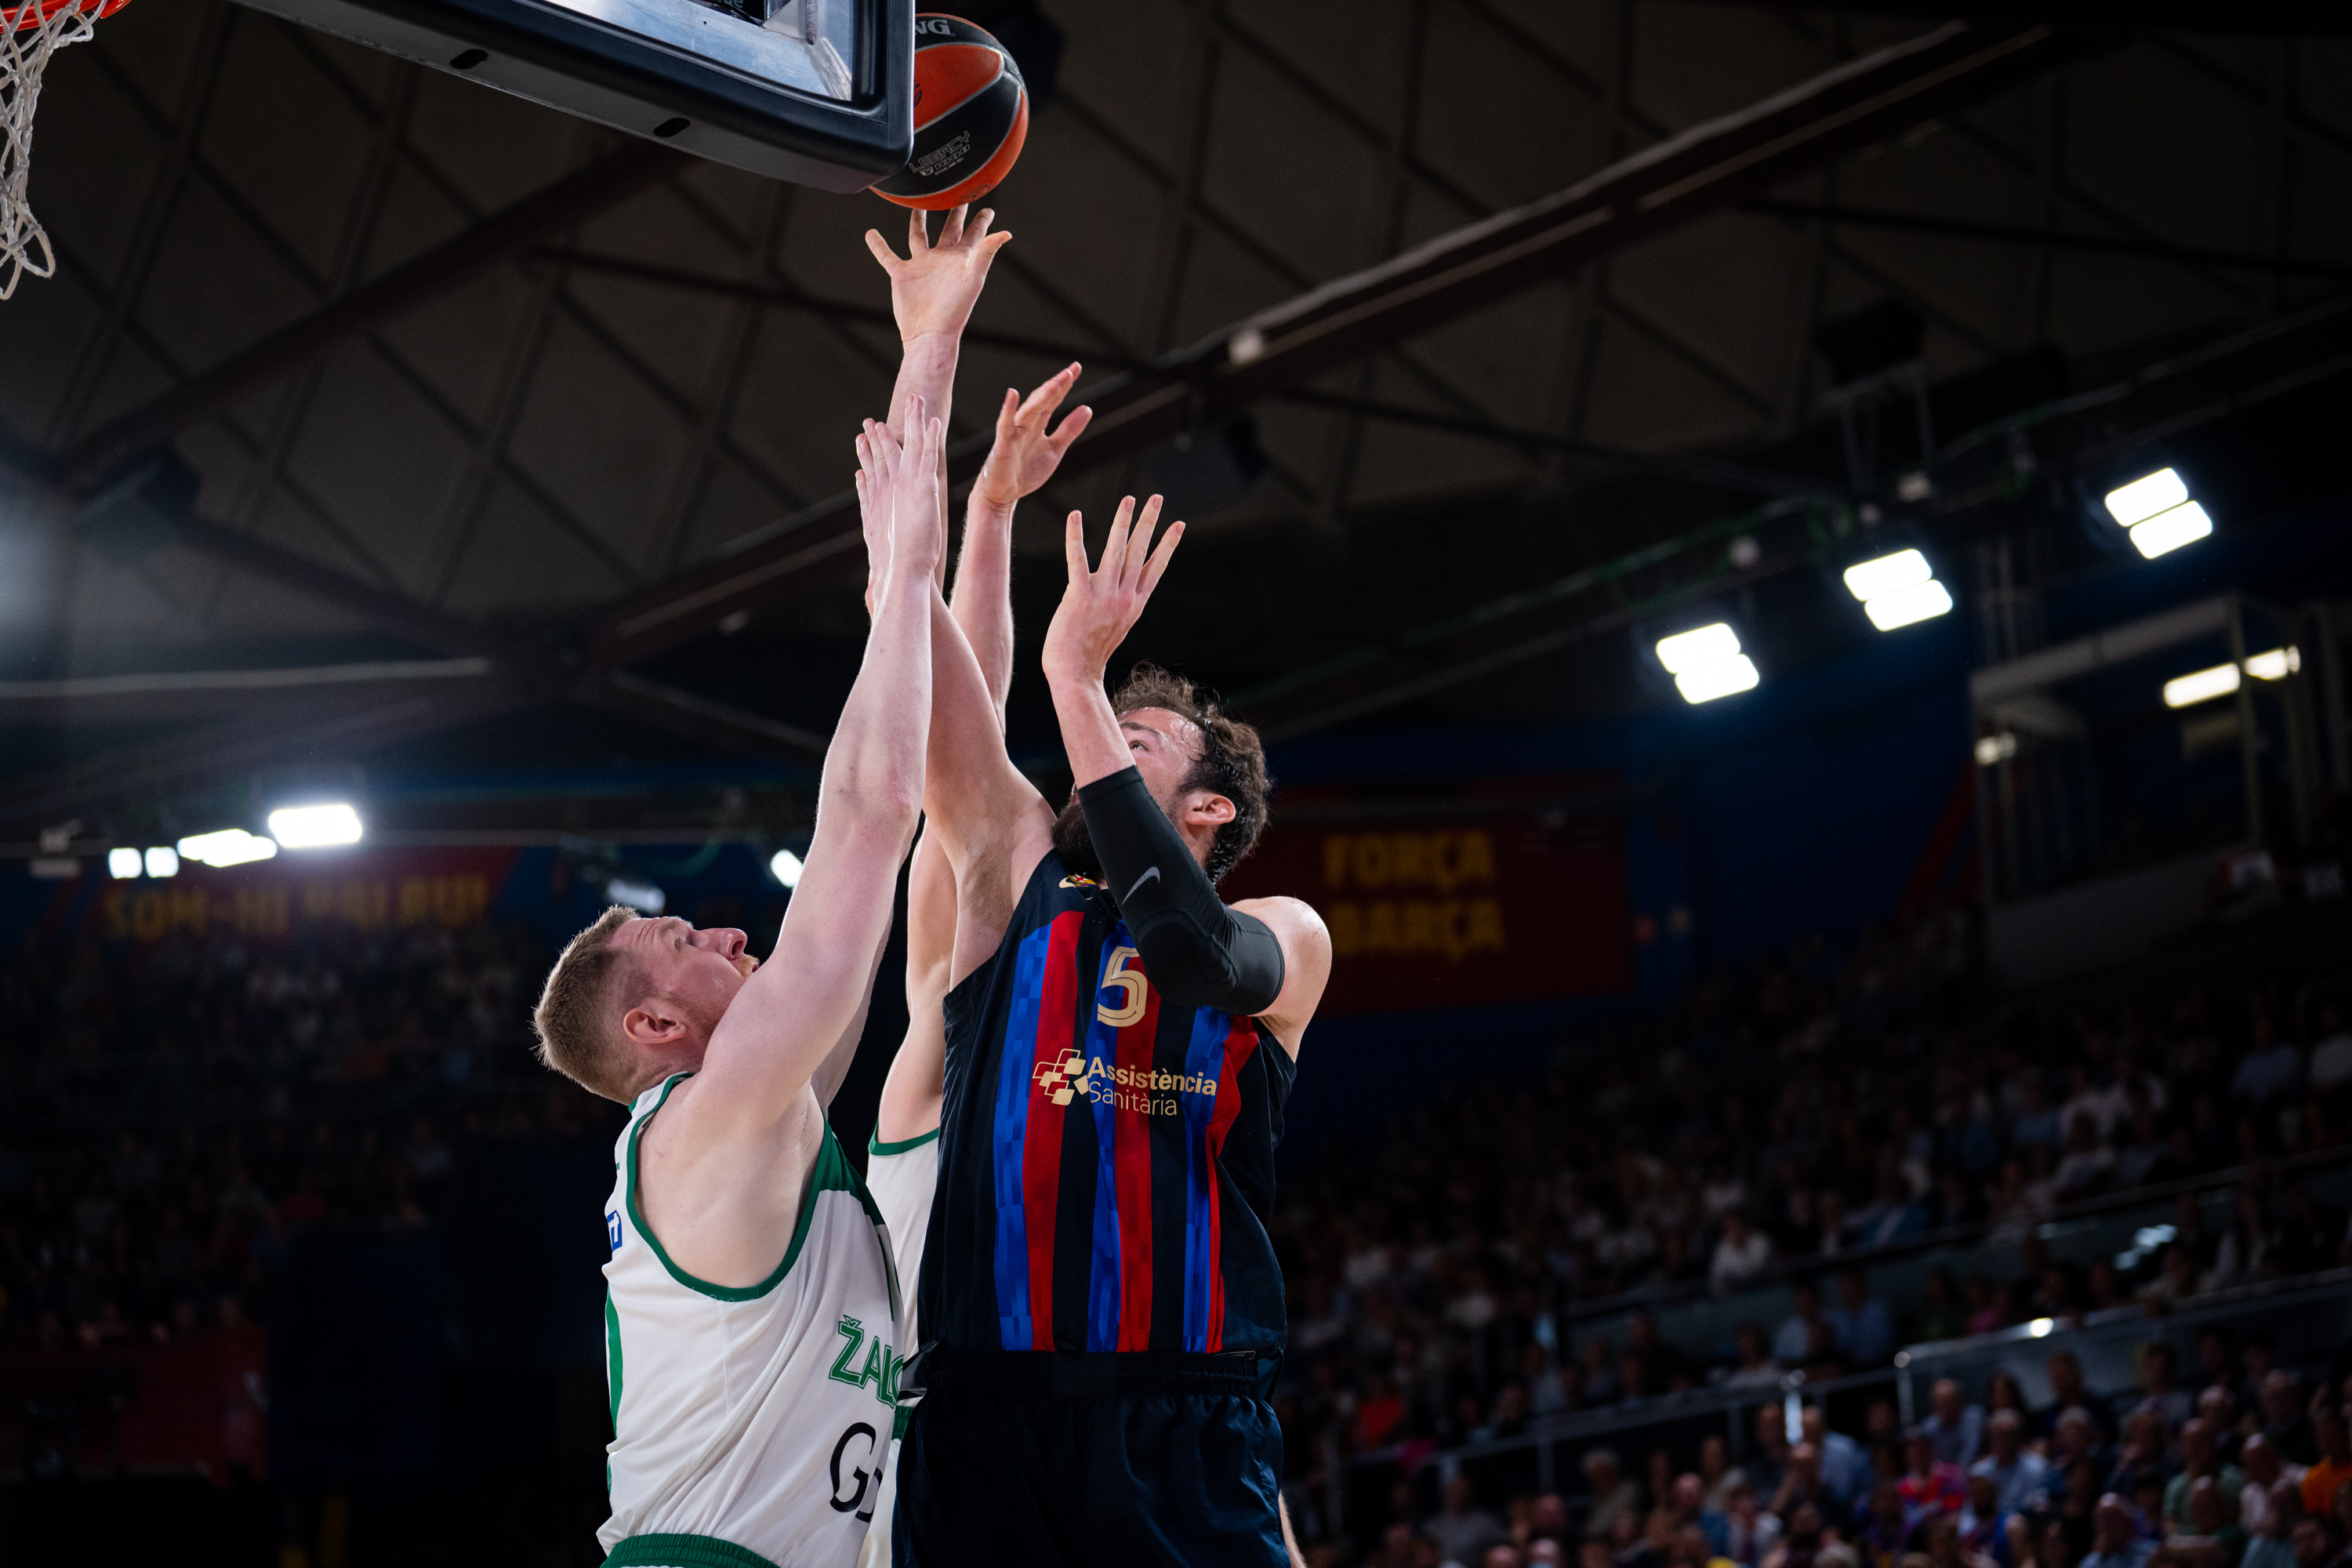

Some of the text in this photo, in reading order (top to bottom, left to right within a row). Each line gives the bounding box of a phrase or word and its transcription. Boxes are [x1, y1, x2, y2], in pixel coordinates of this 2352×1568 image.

[909, 130, 971, 172] LEGACY
[1097, 946, 1149, 1028] 5
[1087, 1056, 1218, 1097] Assistència
[1088, 1080, 1178, 1116] Sanitària
